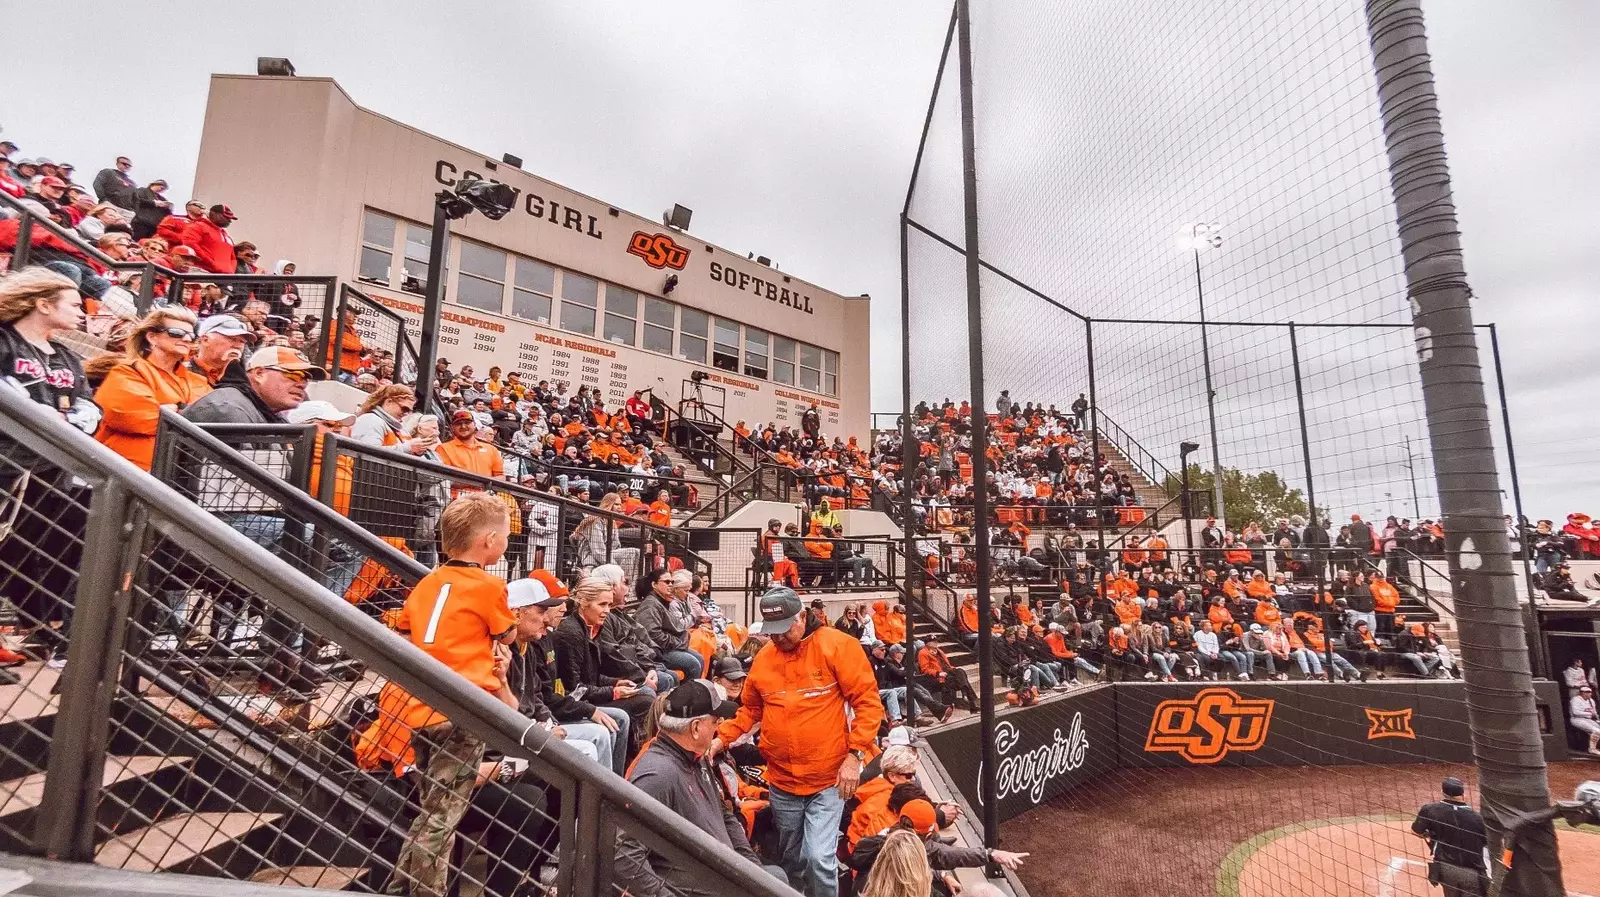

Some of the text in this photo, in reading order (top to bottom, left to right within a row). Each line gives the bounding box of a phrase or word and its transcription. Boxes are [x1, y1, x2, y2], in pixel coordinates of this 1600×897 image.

[630, 233, 688, 270] OSU
[710, 261, 814, 314] SOFTBALL
[440, 311, 505, 333] HAMPIONS
[473, 342, 495, 353] 1994
[474, 332, 497, 343] 1990
[534, 333, 616, 358] NCAA REGIONALS
[518, 352, 627, 380] 1990 1991 1992 1993
[519, 342, 628, 372] 1982 1984 1988 1989
[517, 361, 628, 389] 1996 1997 1998 2003
[722, 378, 760, 391] REGIONALS
[608, 388, 625, 398] 2011
[733, 389, 747, 398] 2021
[629, 478, 645, 491] 202
[1086, 509, 1097, 518] 204
[423, 582, 452, 645] 1
[1149, 690, 1272, 760] OSU
